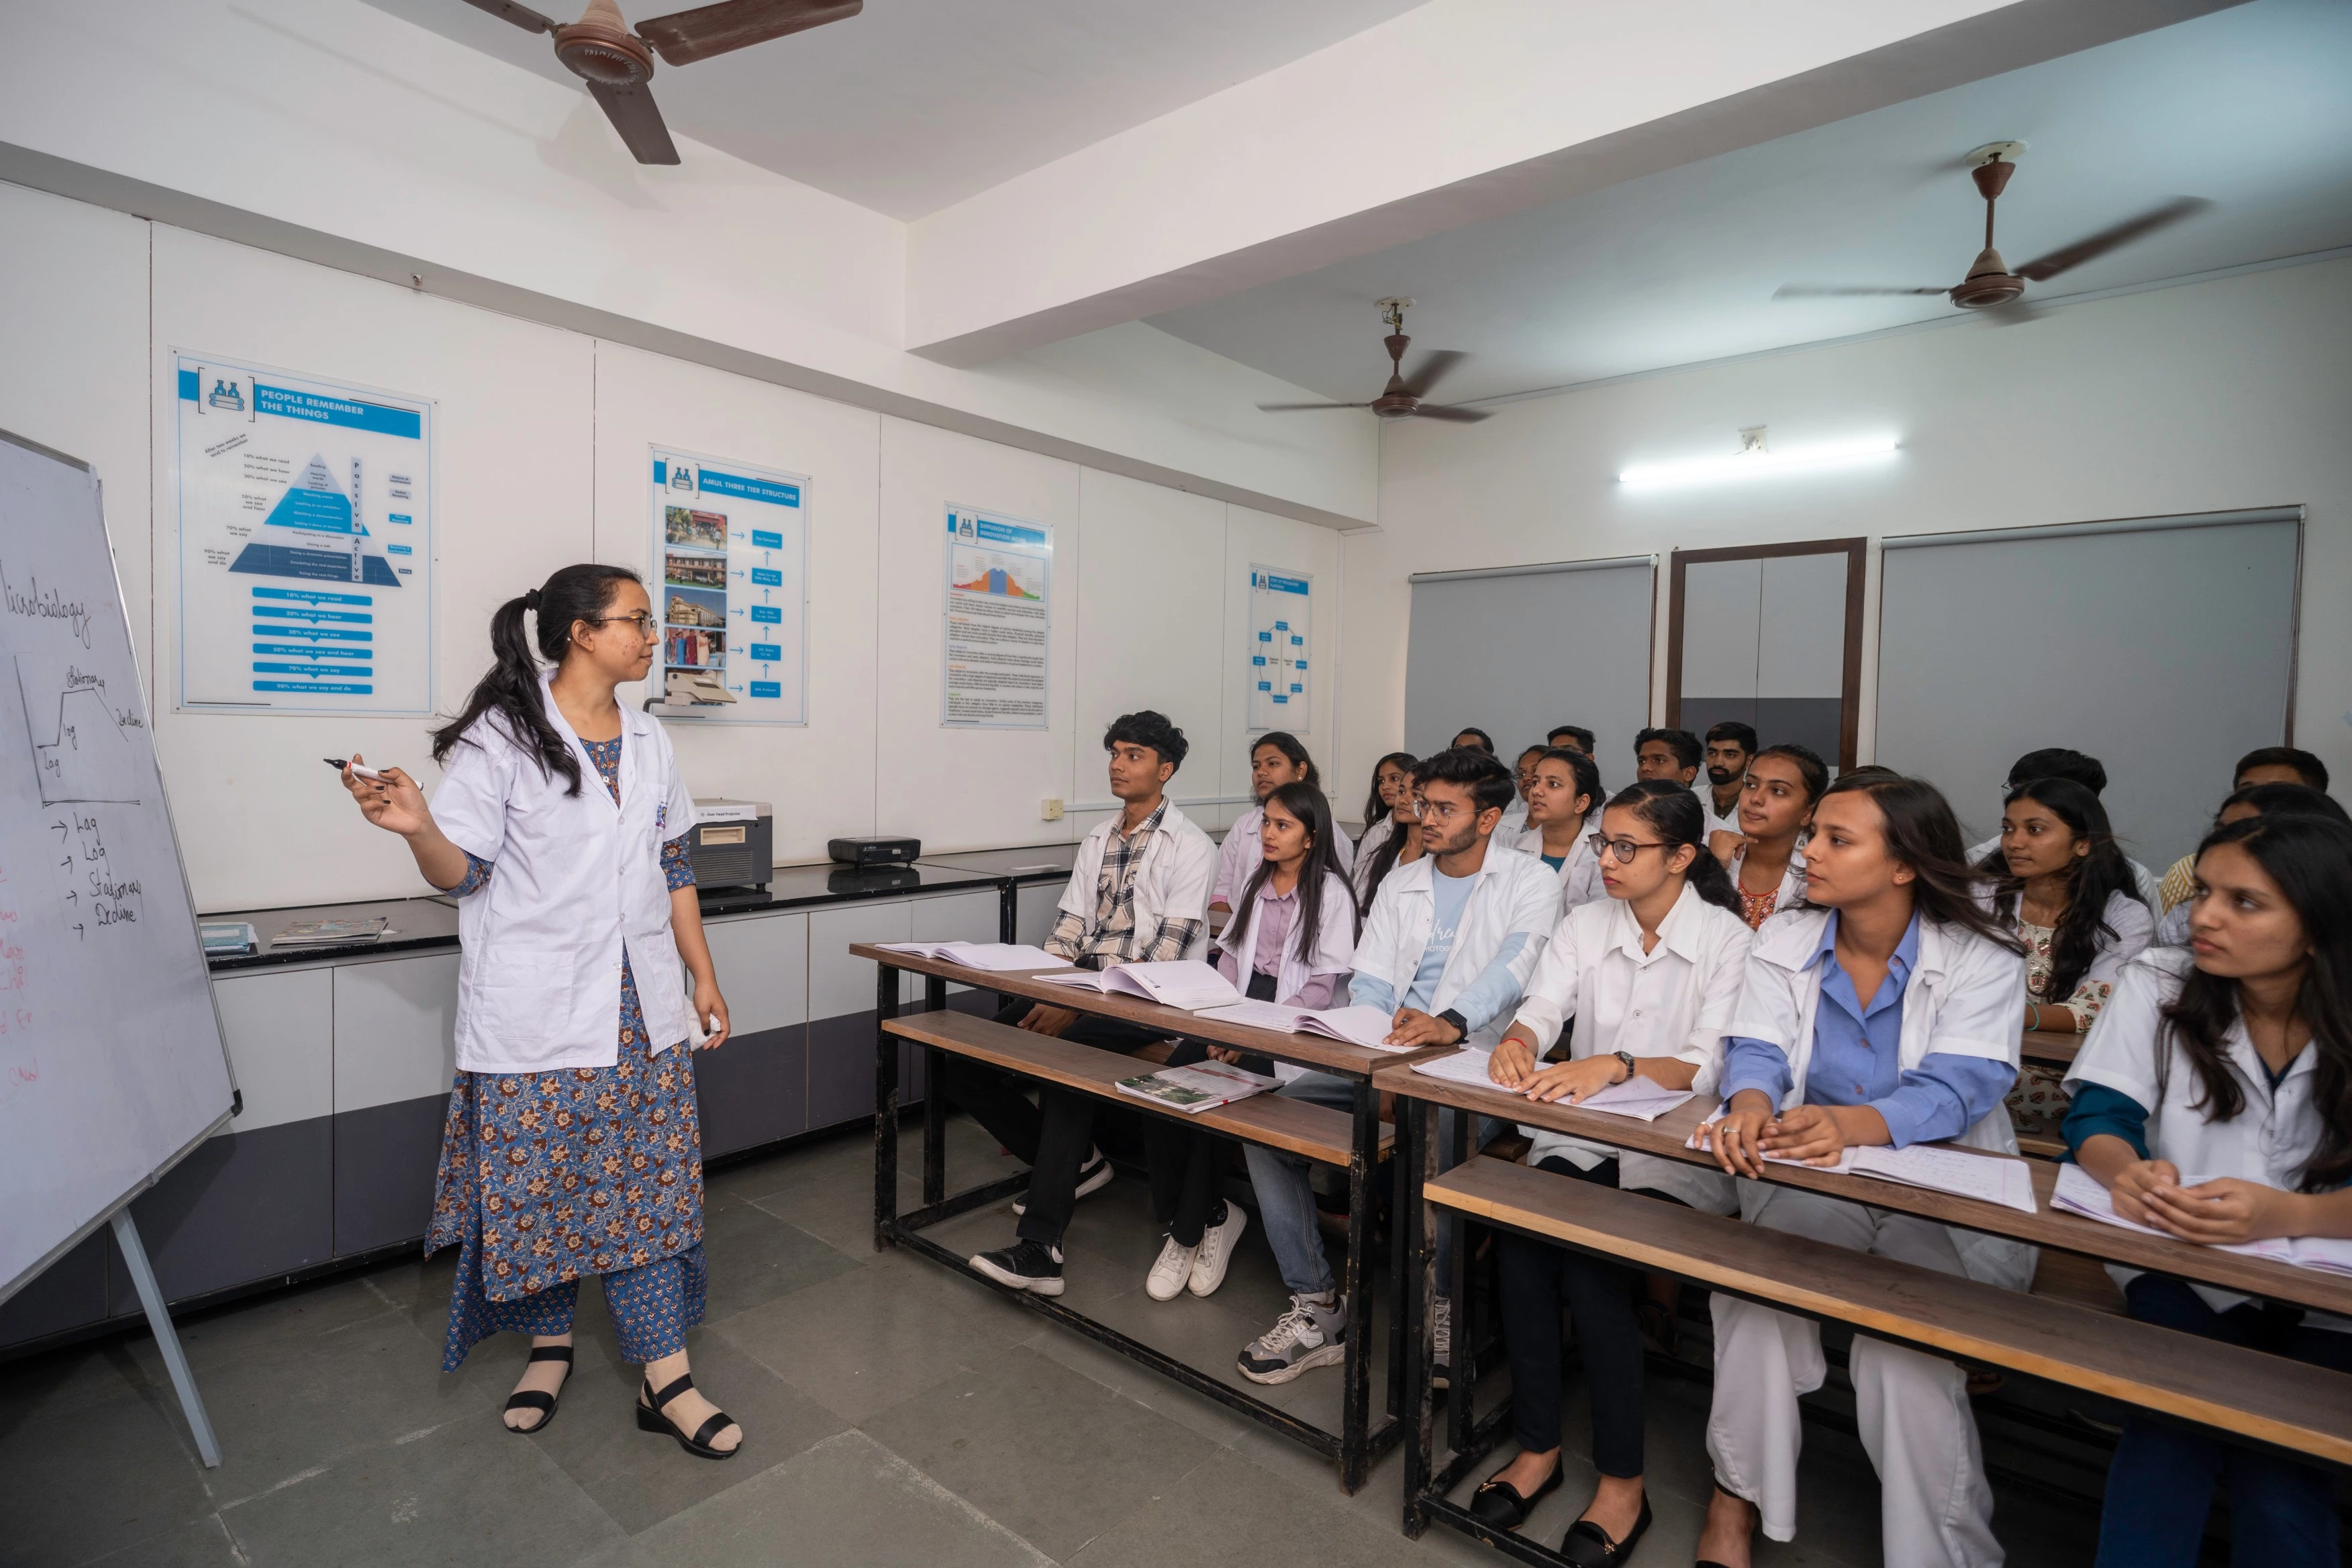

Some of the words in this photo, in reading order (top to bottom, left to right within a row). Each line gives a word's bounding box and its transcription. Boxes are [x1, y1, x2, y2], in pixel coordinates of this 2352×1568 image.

[261, 389, 303, 404] PEOPLE
[306, 397, 364, 415] REMEMBER
[261, 401, 283, 411] THE
[286, 405, 329, 420] THINGS
[225, 436, 239, 444] weeks
[226, 438, 248, 451] remember
[703, 478, 723, 487] AMUL
[725, 481, 745, 491] THREE
[747, 486, 761, 494] TIER
[762, 489, 796, 501] STRUCTURE
[980, 523, 1005, 533] DIFFUSION
[980, 530, 1010, 540] INNOVATION
[0, 559, 91, 650] icrobiology
[67, 666, 106, 698] Stationary
[116, 708, 144, 728] Decline
[74, 812, 101, 846] Lag
[82, 841, 110, 876] Log
[89, 868, 144, 922] Stationary
[95, 900, 137, 926] Decline
